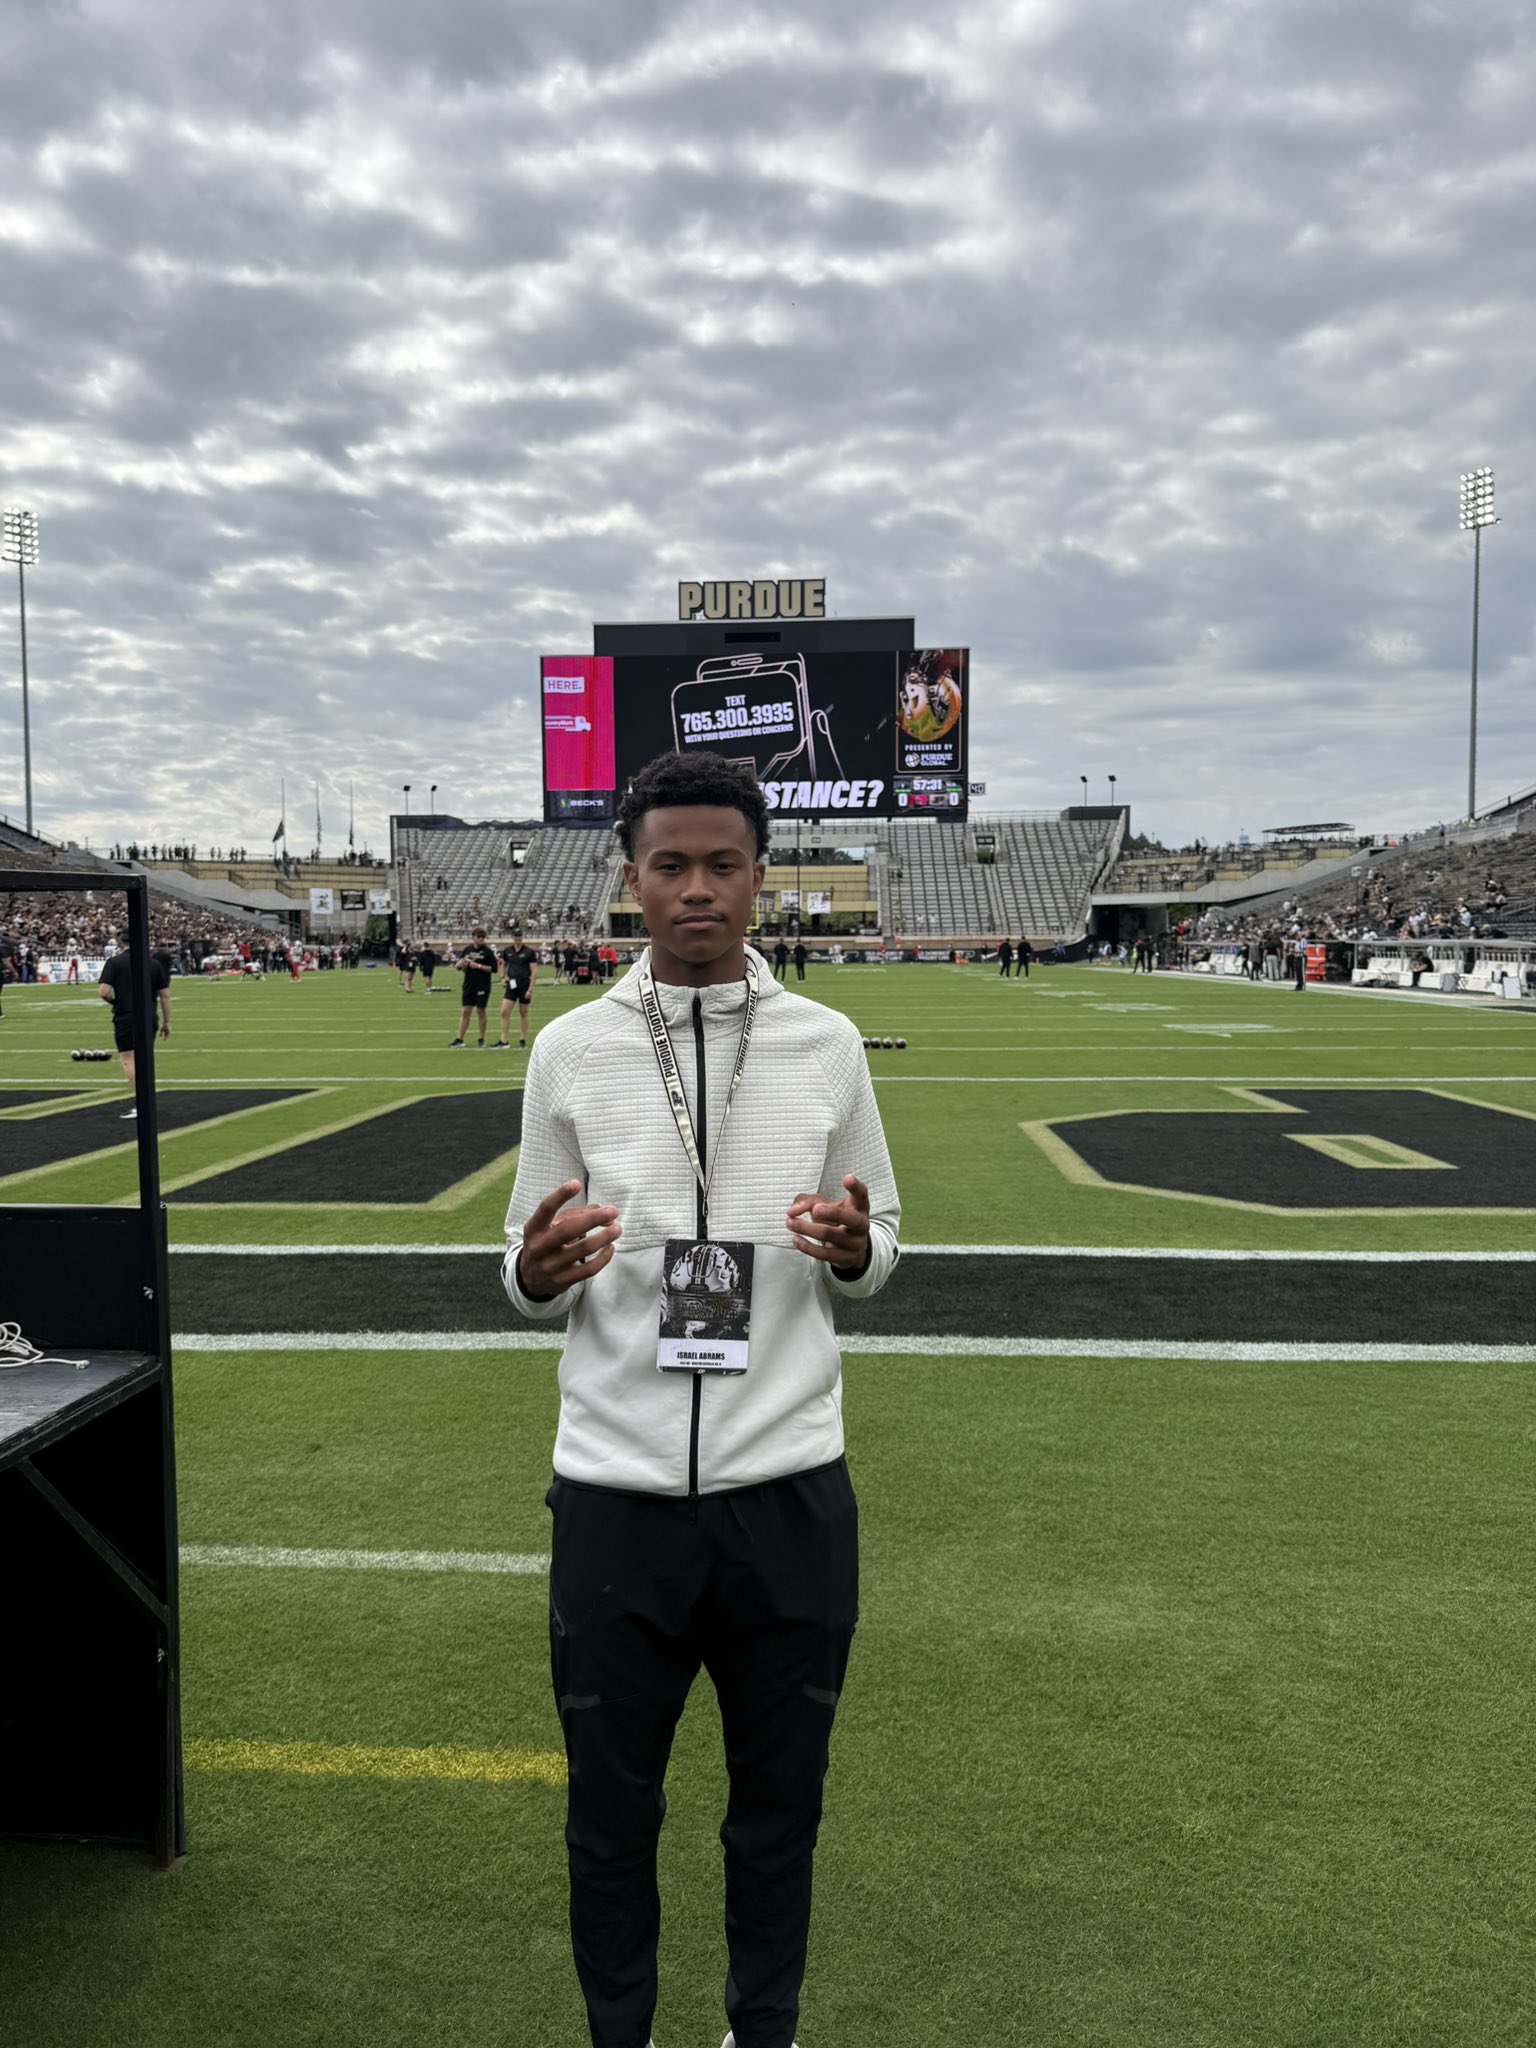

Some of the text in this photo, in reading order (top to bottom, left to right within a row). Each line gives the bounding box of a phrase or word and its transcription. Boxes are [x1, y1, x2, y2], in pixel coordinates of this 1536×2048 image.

[679, 578, 826, 621] PURDUE
[547, 680, 582, 690] HERE.
[725, 694, 746, 707] TEXT
[680, 701, 795, 733] 765.300.3935
[684, 723, 794, 744] WITH YOUR QUESTIONS OR CONCERNS
[920, 753, 953, 761] PURDUE
[913, 779, 942, 790] 57:31
[971, 785, 984, 793] 40
[569, 799, 604, 807] BECK'S
[898, 793, 908, 807] 0
[949, 792, 959, 806] 0
[643, 990, 676, 1078] PURDUE FOOTBALL
[735, 1036, 749, 1077] PURDUE
[677, 1351, 726, 1361] ISRAEL ABRAMS
